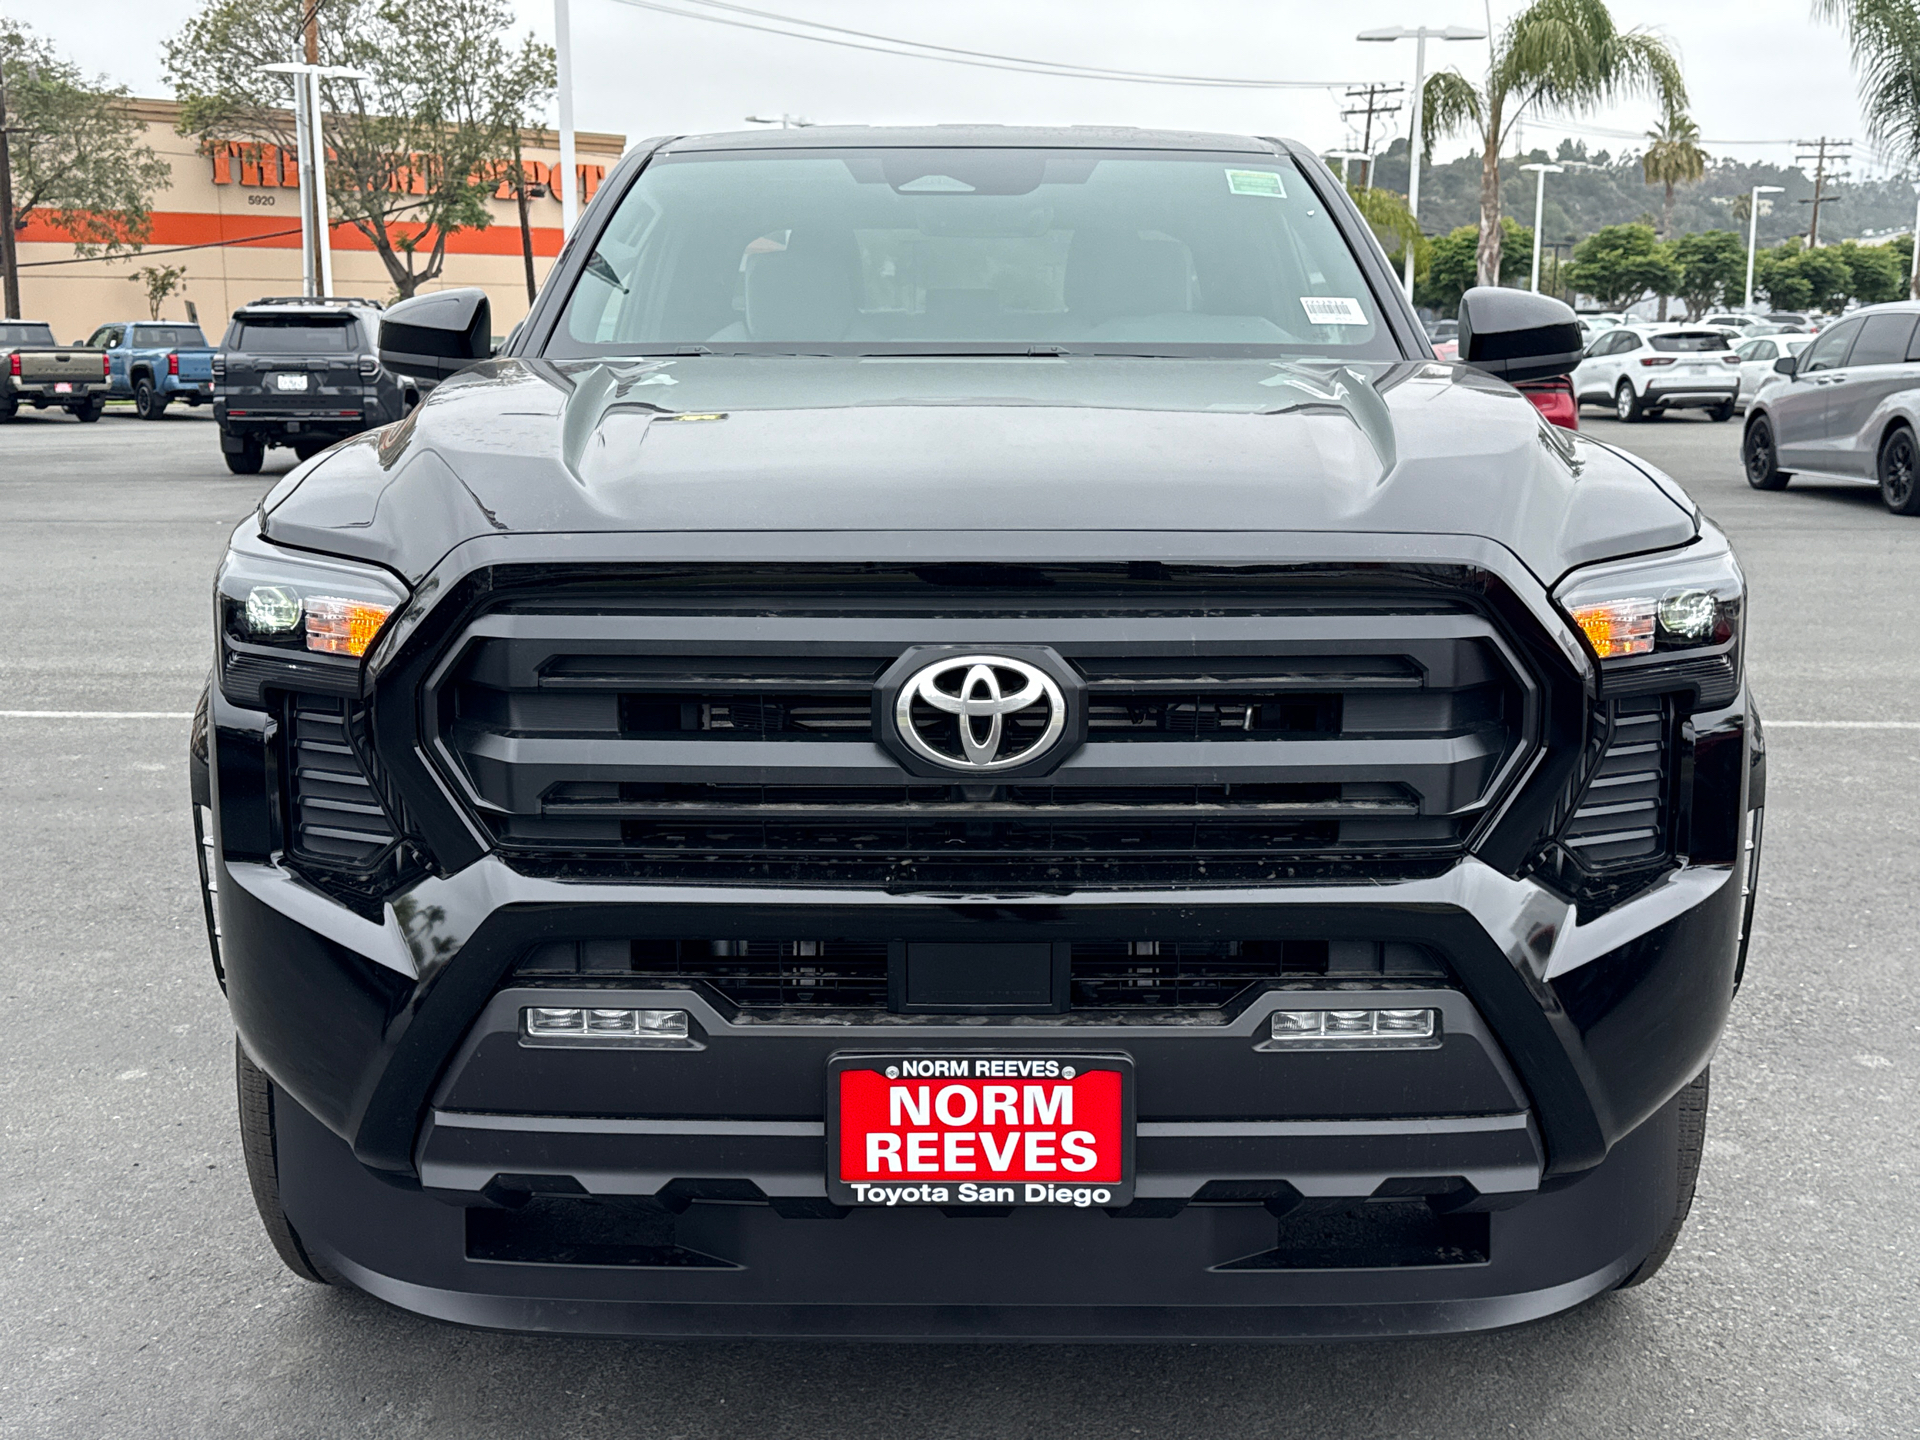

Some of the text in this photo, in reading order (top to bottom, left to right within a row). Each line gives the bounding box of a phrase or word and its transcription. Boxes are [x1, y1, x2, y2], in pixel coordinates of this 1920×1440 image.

[248, 195, 276, 206] 5920
[902, 1060, 1060, 1077] NORM REEVES
[889, 1084, 1073, 1126] NORM
[866, 1130, 1098, 1173] REEVES
[850, 1182, 1112, 1208] Toyota San Diego
